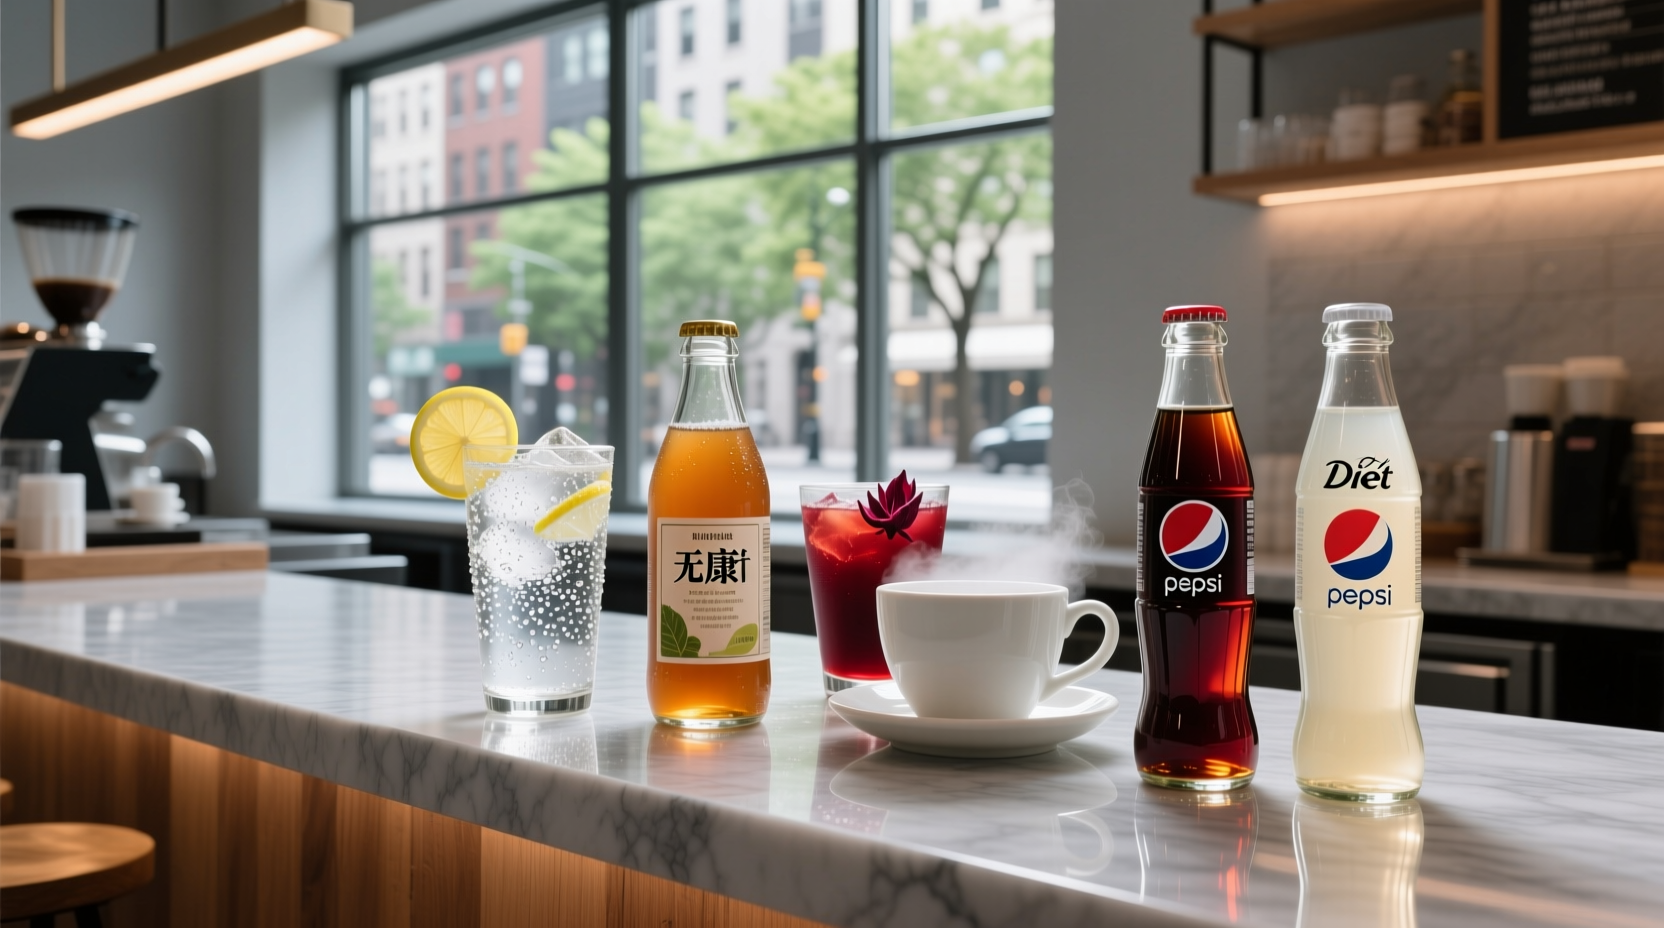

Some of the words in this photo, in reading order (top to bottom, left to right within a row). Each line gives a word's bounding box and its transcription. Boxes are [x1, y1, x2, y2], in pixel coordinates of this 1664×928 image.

[1323, 457, 1393, 489] Diet
[1164, 574, 1222, 597] pepsi
[1327, 584, 1392, 611] pepsi
